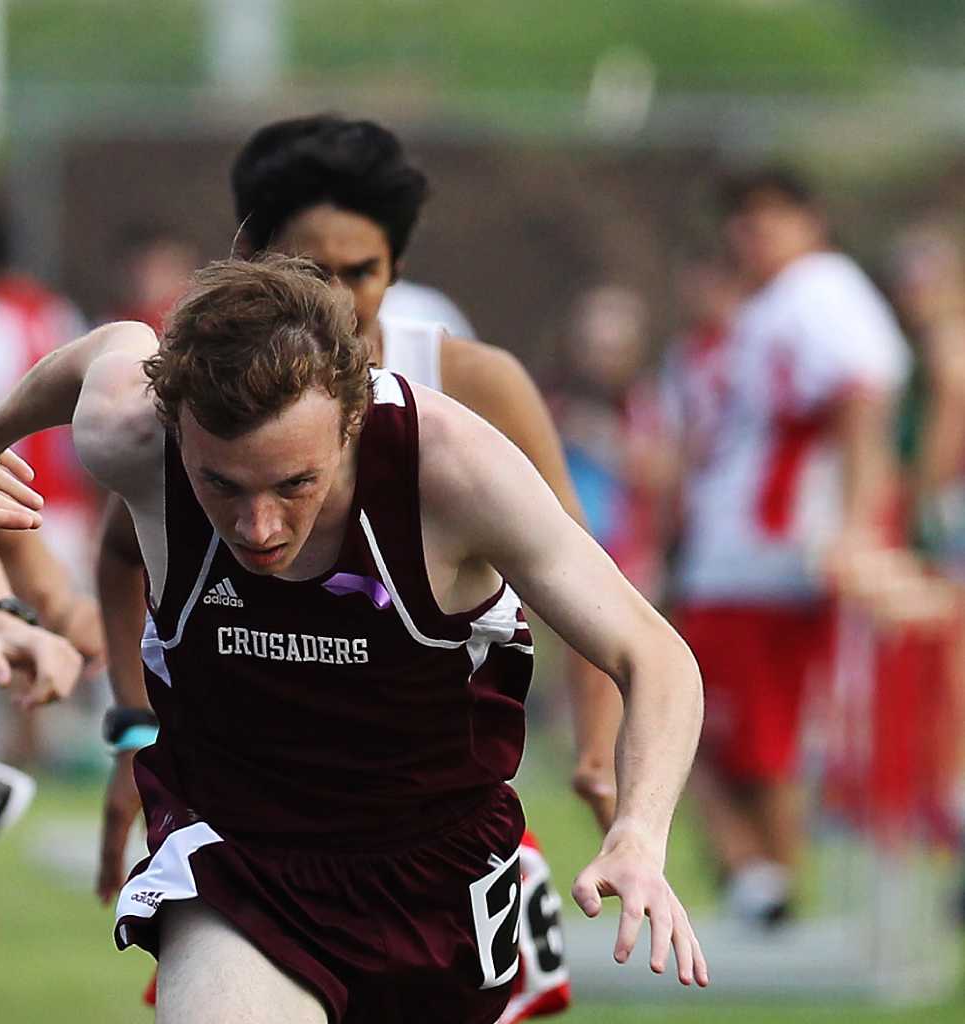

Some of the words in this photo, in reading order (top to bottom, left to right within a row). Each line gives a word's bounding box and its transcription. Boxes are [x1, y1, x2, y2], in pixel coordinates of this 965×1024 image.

[203, 593, 244, 608] adidas
[217, 626, 369, 664] CRUSADERS
[485, 856, 520, 979] 2
